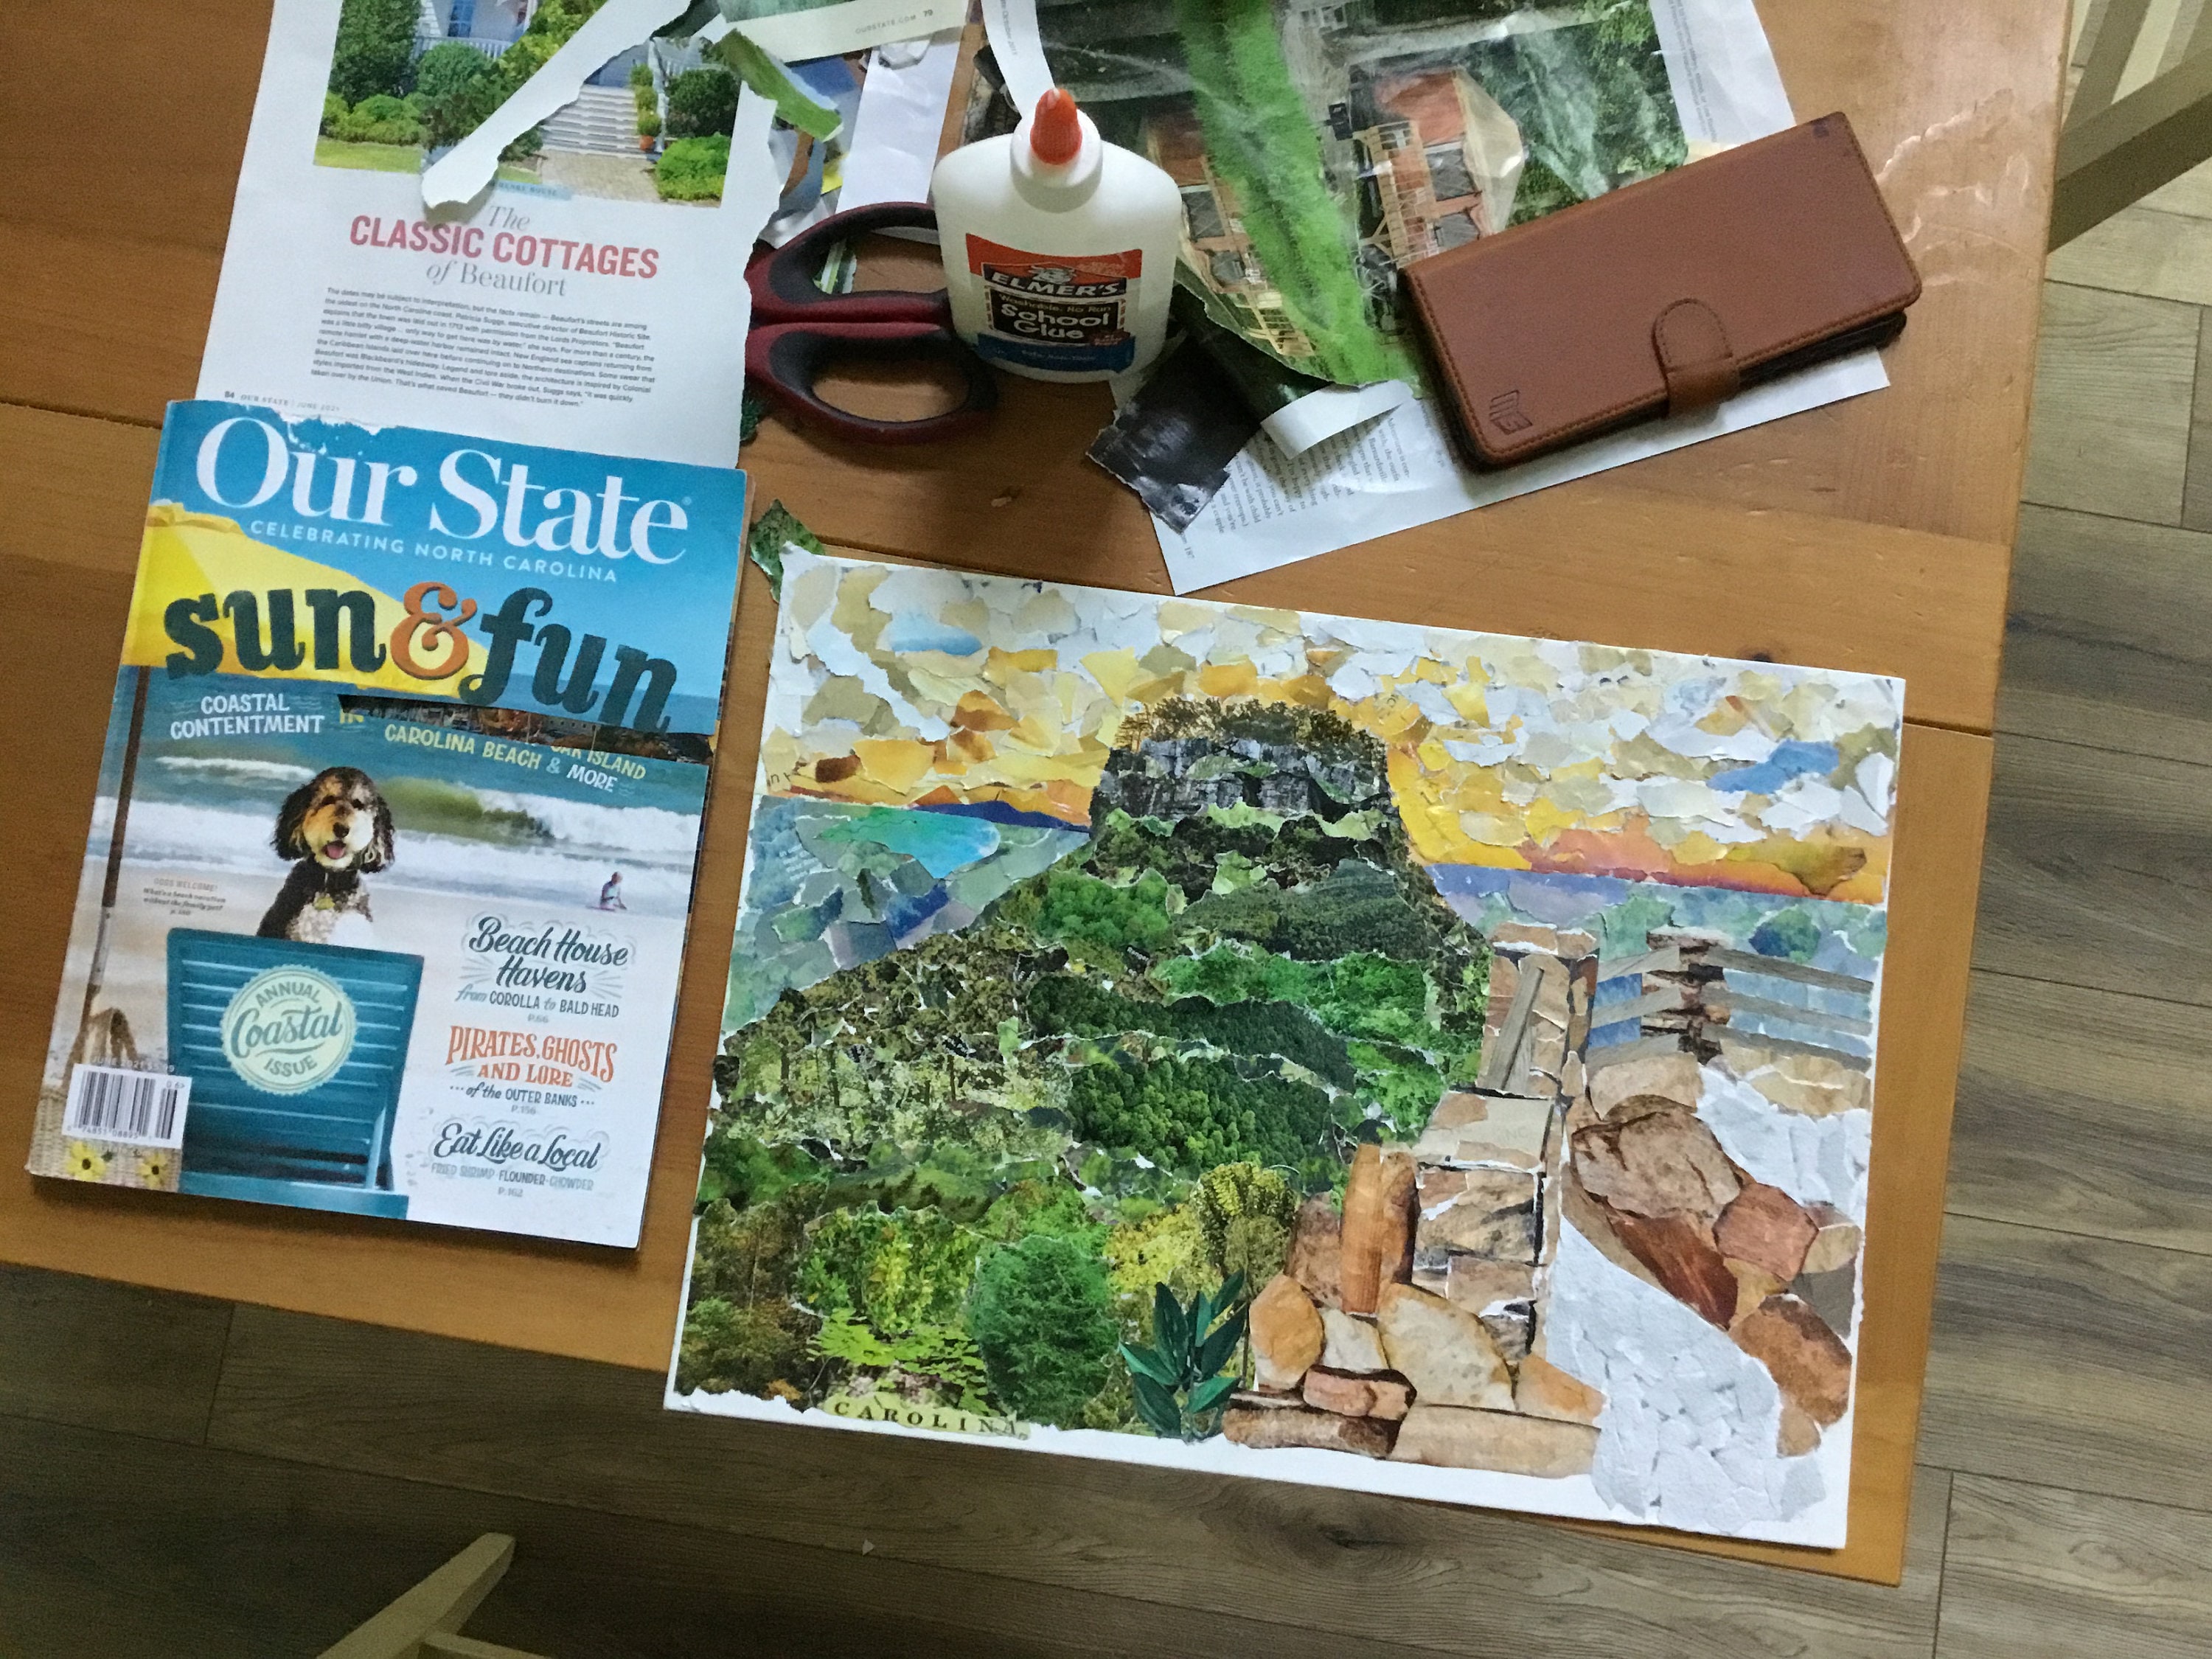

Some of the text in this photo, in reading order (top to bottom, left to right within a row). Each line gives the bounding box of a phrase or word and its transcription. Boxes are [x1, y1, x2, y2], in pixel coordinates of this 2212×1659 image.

[924, 9, 933, 17] 79
[487, 205, 531, 231] The
[349, 215, 659, 279] CLASSIC COTTAGES
[426, 260, 567, 296] of Beaufort
[991, 271, 1119, 296] ELMER'S
[1001, 303, 1109, 327] School
[1067, 305, 1084, 313] No
[1088, 304, 1111, 313] Run
[1013, 319, 1085, 339] Glue
[224, 391, 234, 399] 84
[240, 393, 259, 402] OUR
[262, 396, 288, 406] STATE
[196, 417, 688, 564] Our State
[1241, 478, 1249, 487] be
[1250, 504, 1261, 523] child
[1300, 501, 1307, 509] to
[1288, 504, 1295, 512] of
[249, 520, 617, 583] CELEBRATING NORTH CAROLINA
[164, 581, 677, 734] sun & fun
[170, 693, 325, 740] COASTAL CONTENTMENT
[384, 723, 619, 793] CAROLINA BEACH & MORE
[586, 749, 647, 780] ISLAND
[469, 916, 628, 966] Beach House
[495, 955, 586, 993] Havens
[255, 981, 321, 1007] ANNUAL
[454, 983, 619, 1018] from COROLLA to BALD HEAD
[231, 1001, 343, 1059] Coastal
[264, 1055, 317, 1077] ISSUE
[541, 1034, 618, 1082] GHOSTS
[477, 1062, 574, 1088] AND LORE
[465, 1082, 577, 1107] of the OUTER BANKS
[434, 1122, 602, 1172] Eat Like a Local
[459, 1166, 495, 1180] SHRIMP
[498, 1170, 546, 1186] FLOUNDER
[549, 1175, 594, 1191] CHOWDER
[834, 1401, 1017, 1436] CAROLINA
